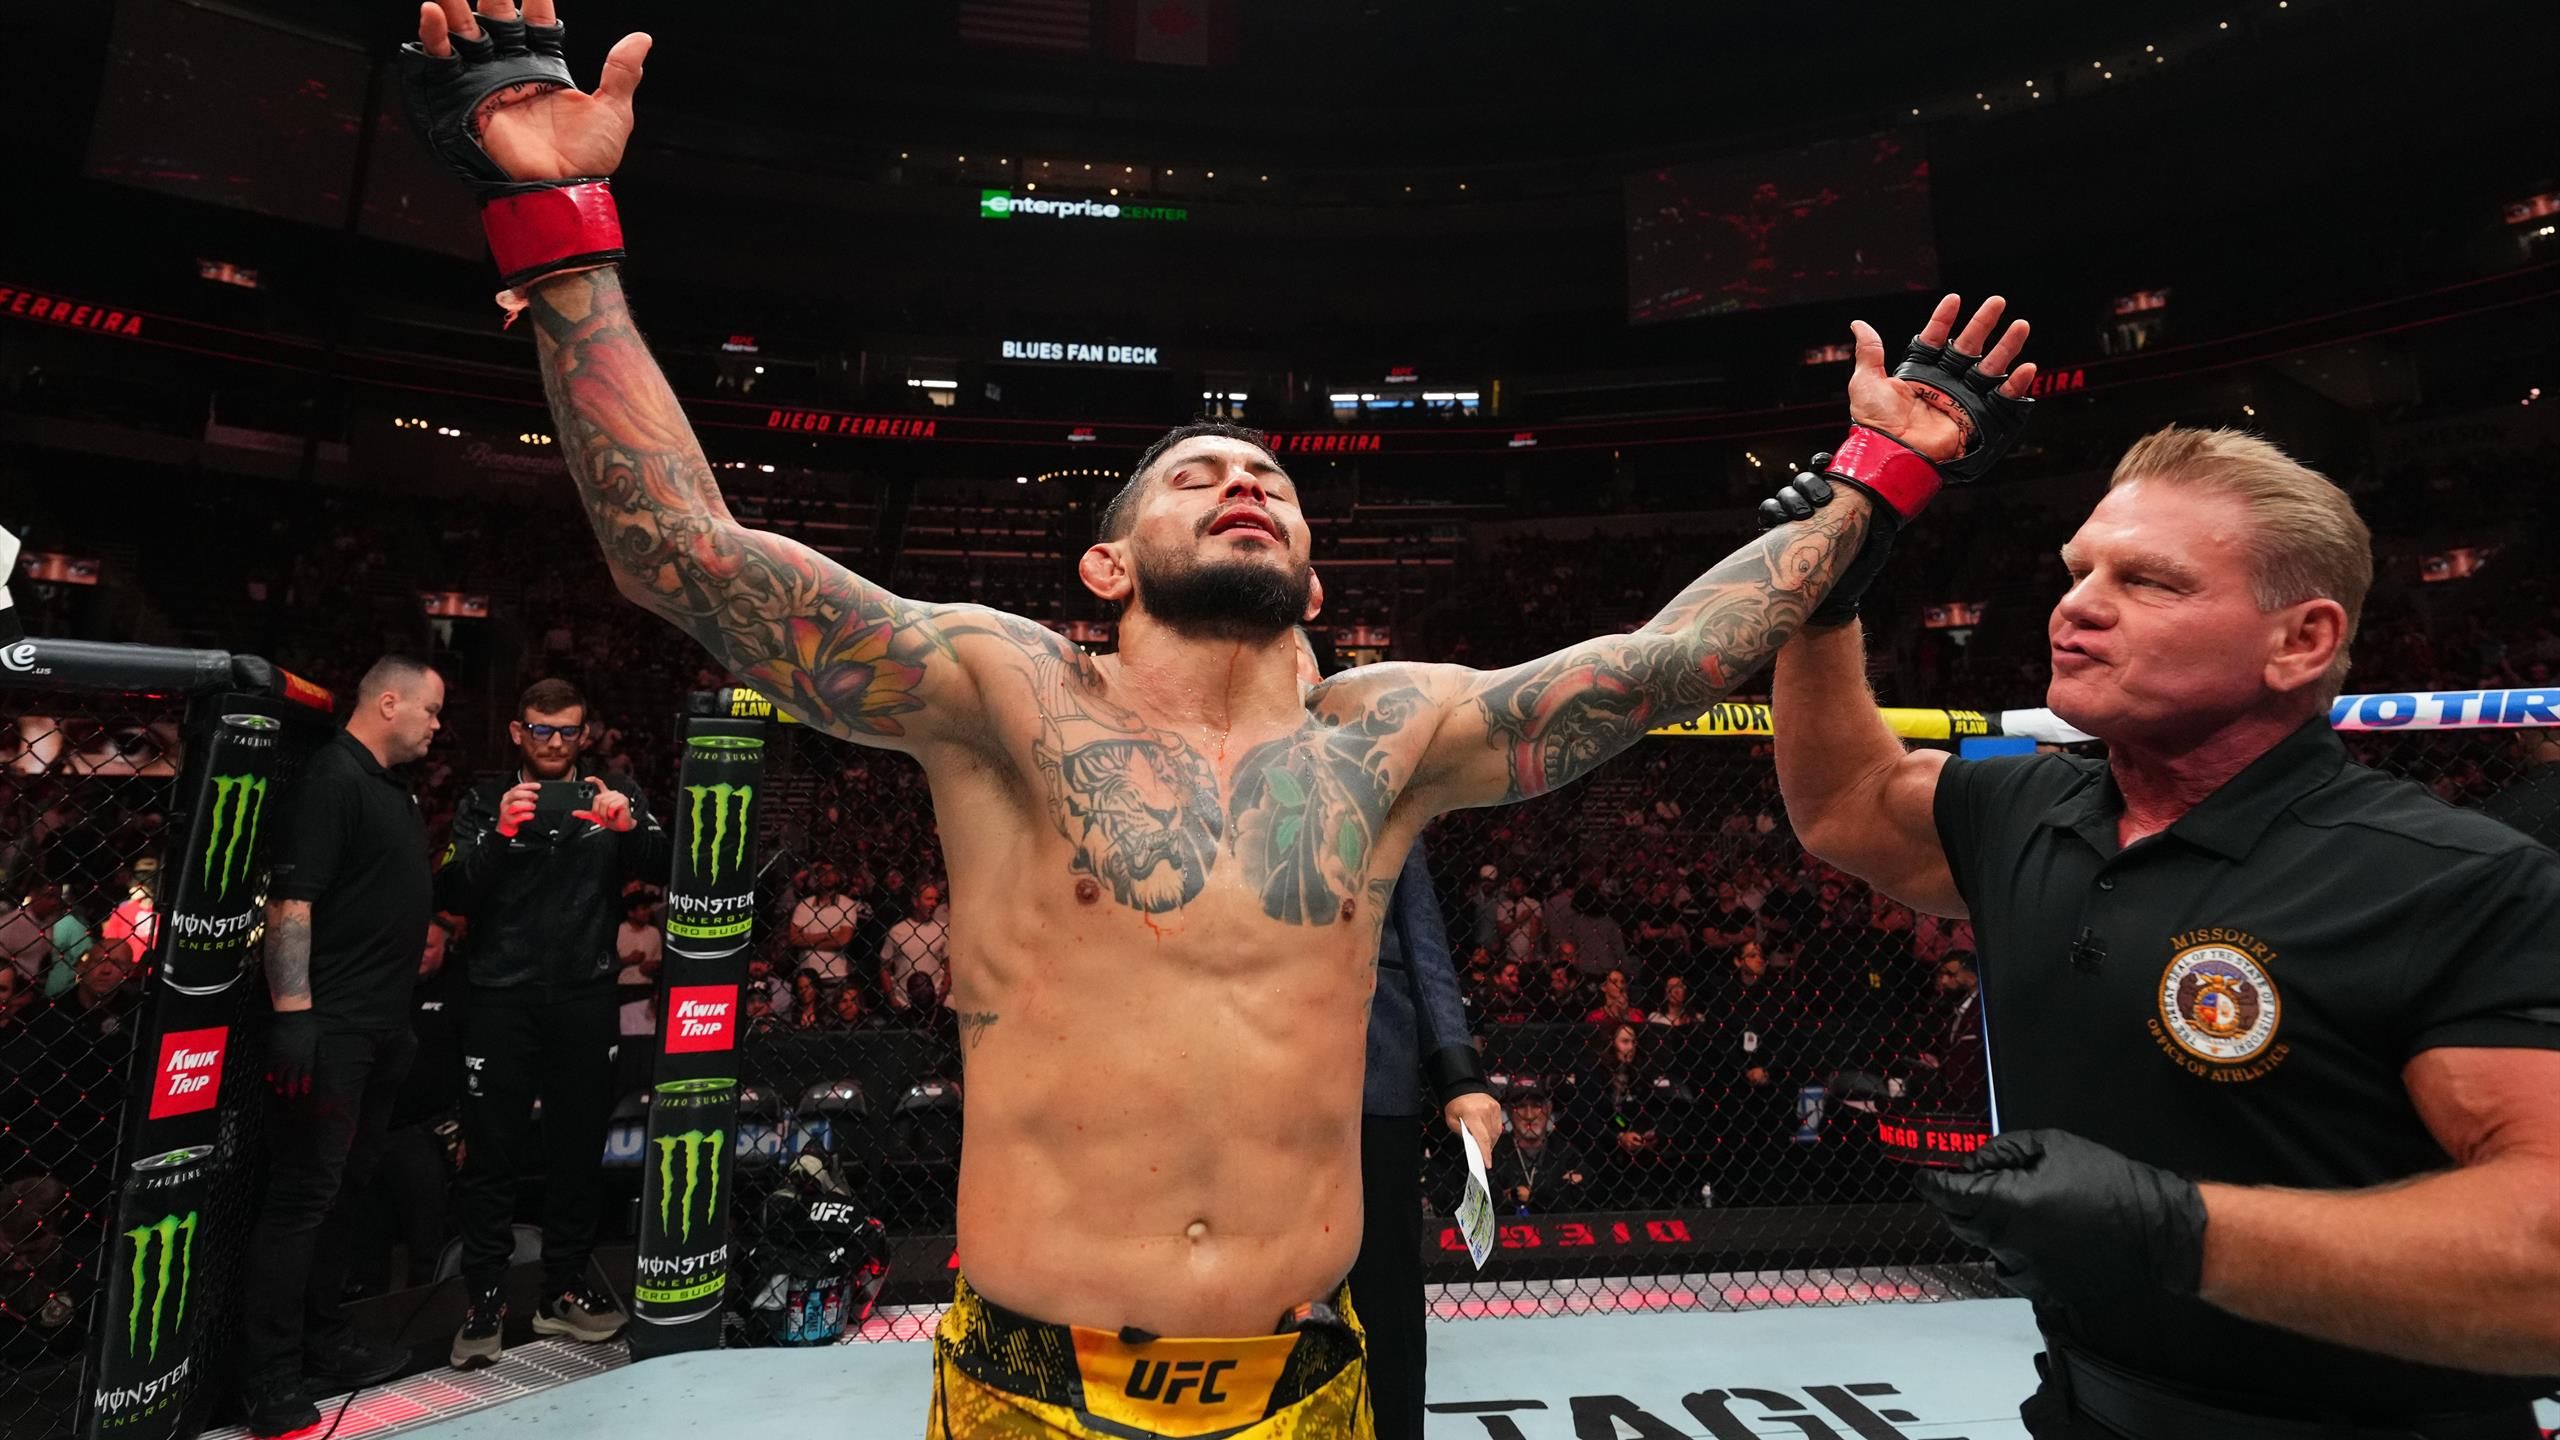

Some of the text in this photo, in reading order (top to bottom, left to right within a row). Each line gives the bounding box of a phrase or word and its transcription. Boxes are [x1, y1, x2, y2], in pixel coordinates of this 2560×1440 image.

[1002, 341, 1157, 364] BLUES FAN DECK
[768, 410, 936, 437] DIEGO FERREIRA
[1290, 435, 1381, 451] FERREIRA
[732, 688, 768, 701] DIA
[731, 702, 772, 717] #LAW
[1955, 720, 1988, 735] #LAW
[676, 912, 745, 924] ENERGY
[2169, 927, 2279, 965] MISSOURI
[809, 1201, 855, 1224] UFC
[1124, 1359, 1239, 1405] UFC
